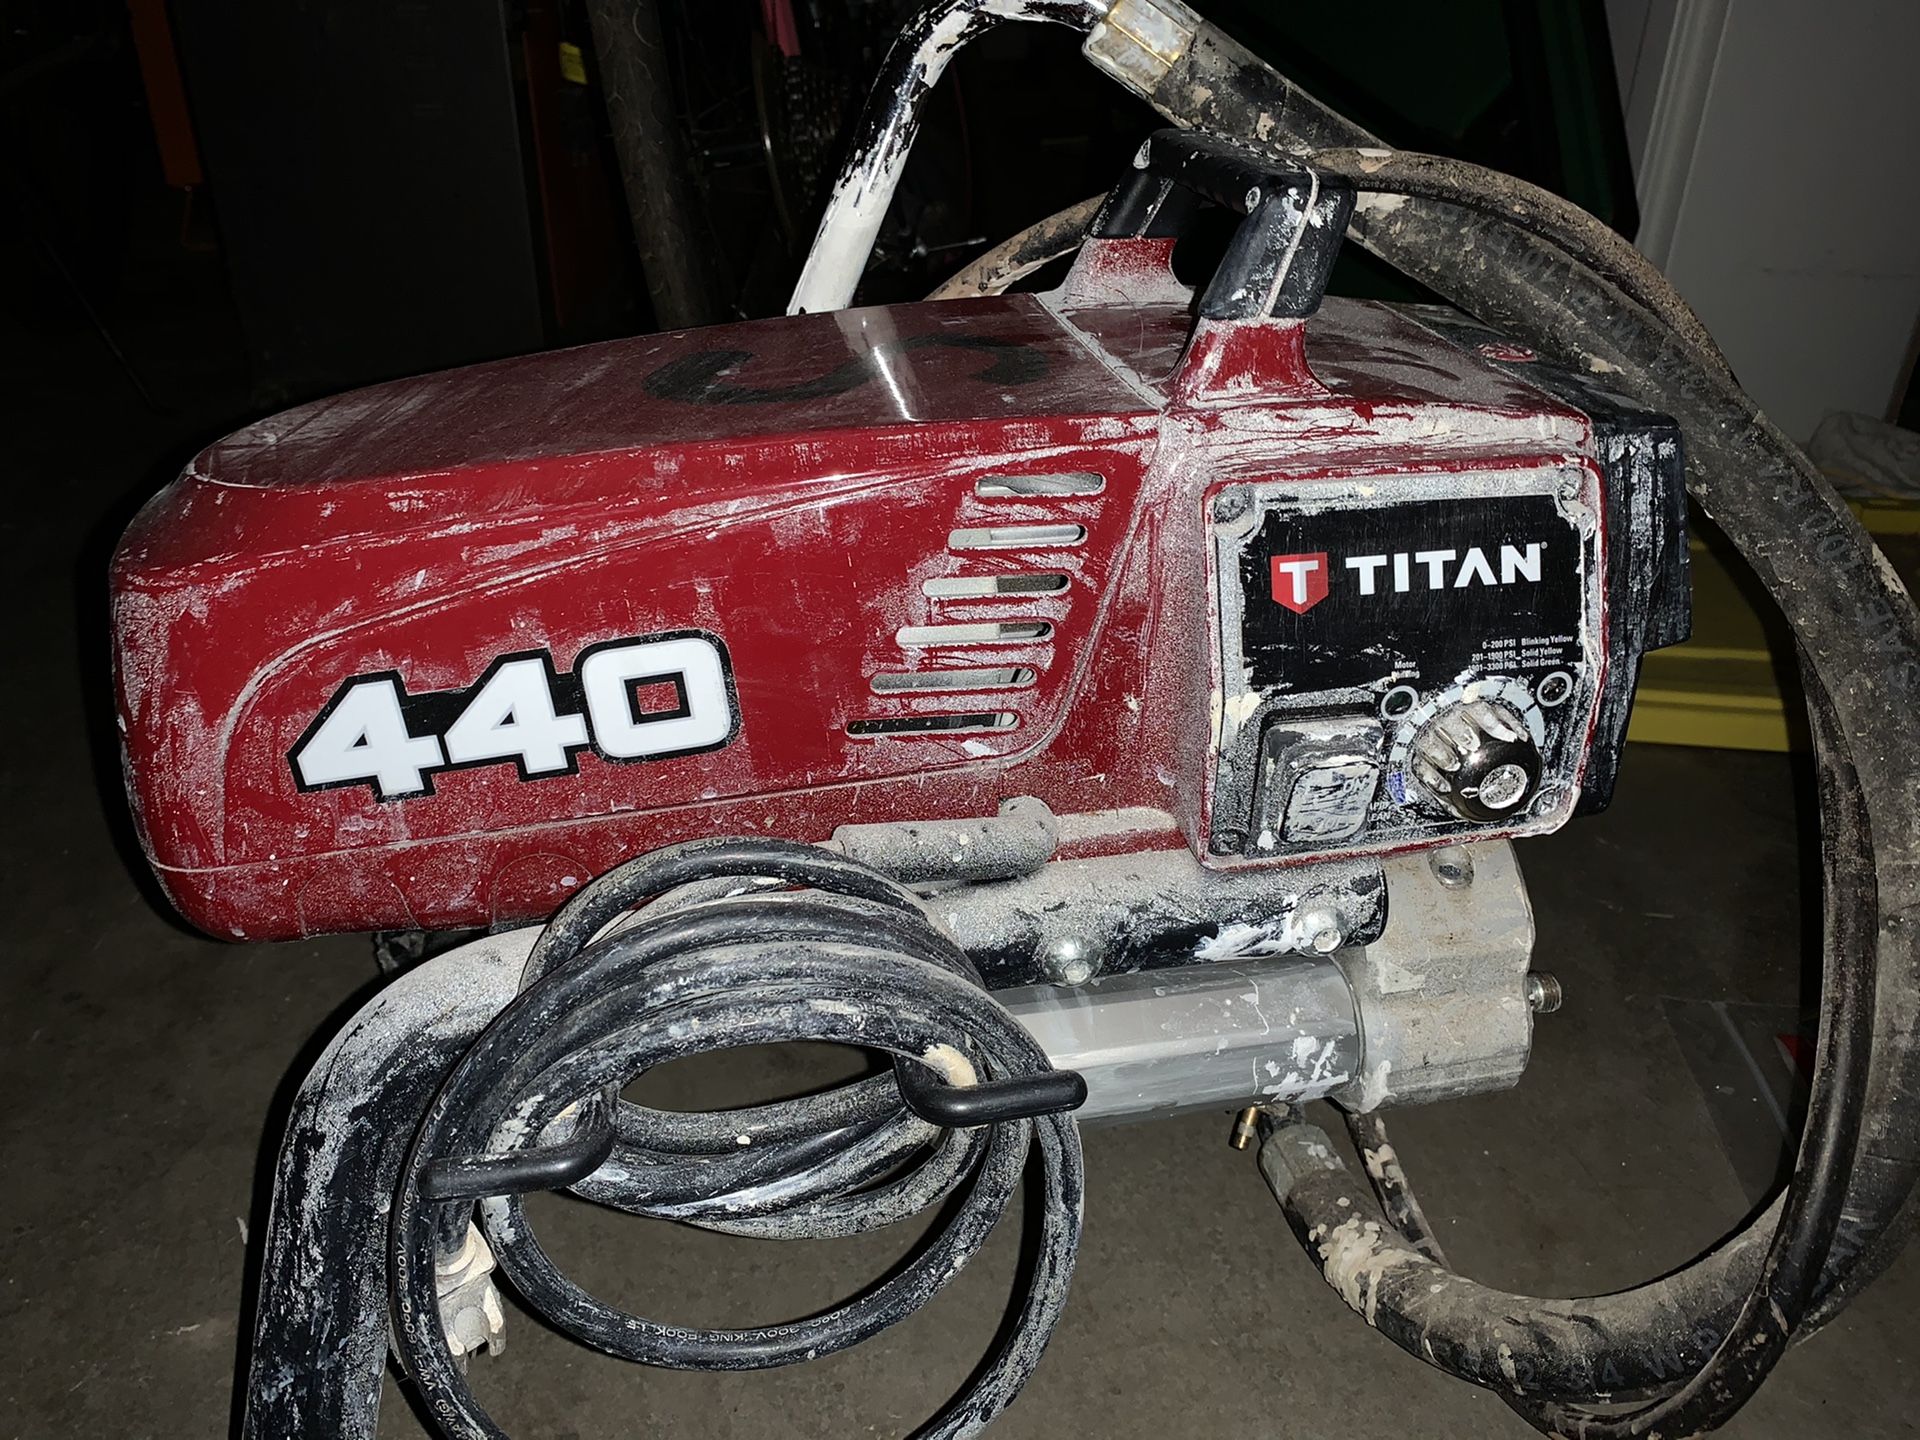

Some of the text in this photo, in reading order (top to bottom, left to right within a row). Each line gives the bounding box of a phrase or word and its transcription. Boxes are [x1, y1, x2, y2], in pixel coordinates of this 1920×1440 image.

[1345, 543, 1542, 596] TITAN
[1521, 637, 1549, 646] Blinking
[1550, 635, 1573, 643] Yellow
[1521, 648, 1539, 657] Solid
[1540, 647, 1563, 657] Yellow
[1394, 661, 1416, 669] Motor
[1521, 660, 1539, 668] Solid
[294, 634, 736, 800] 440
